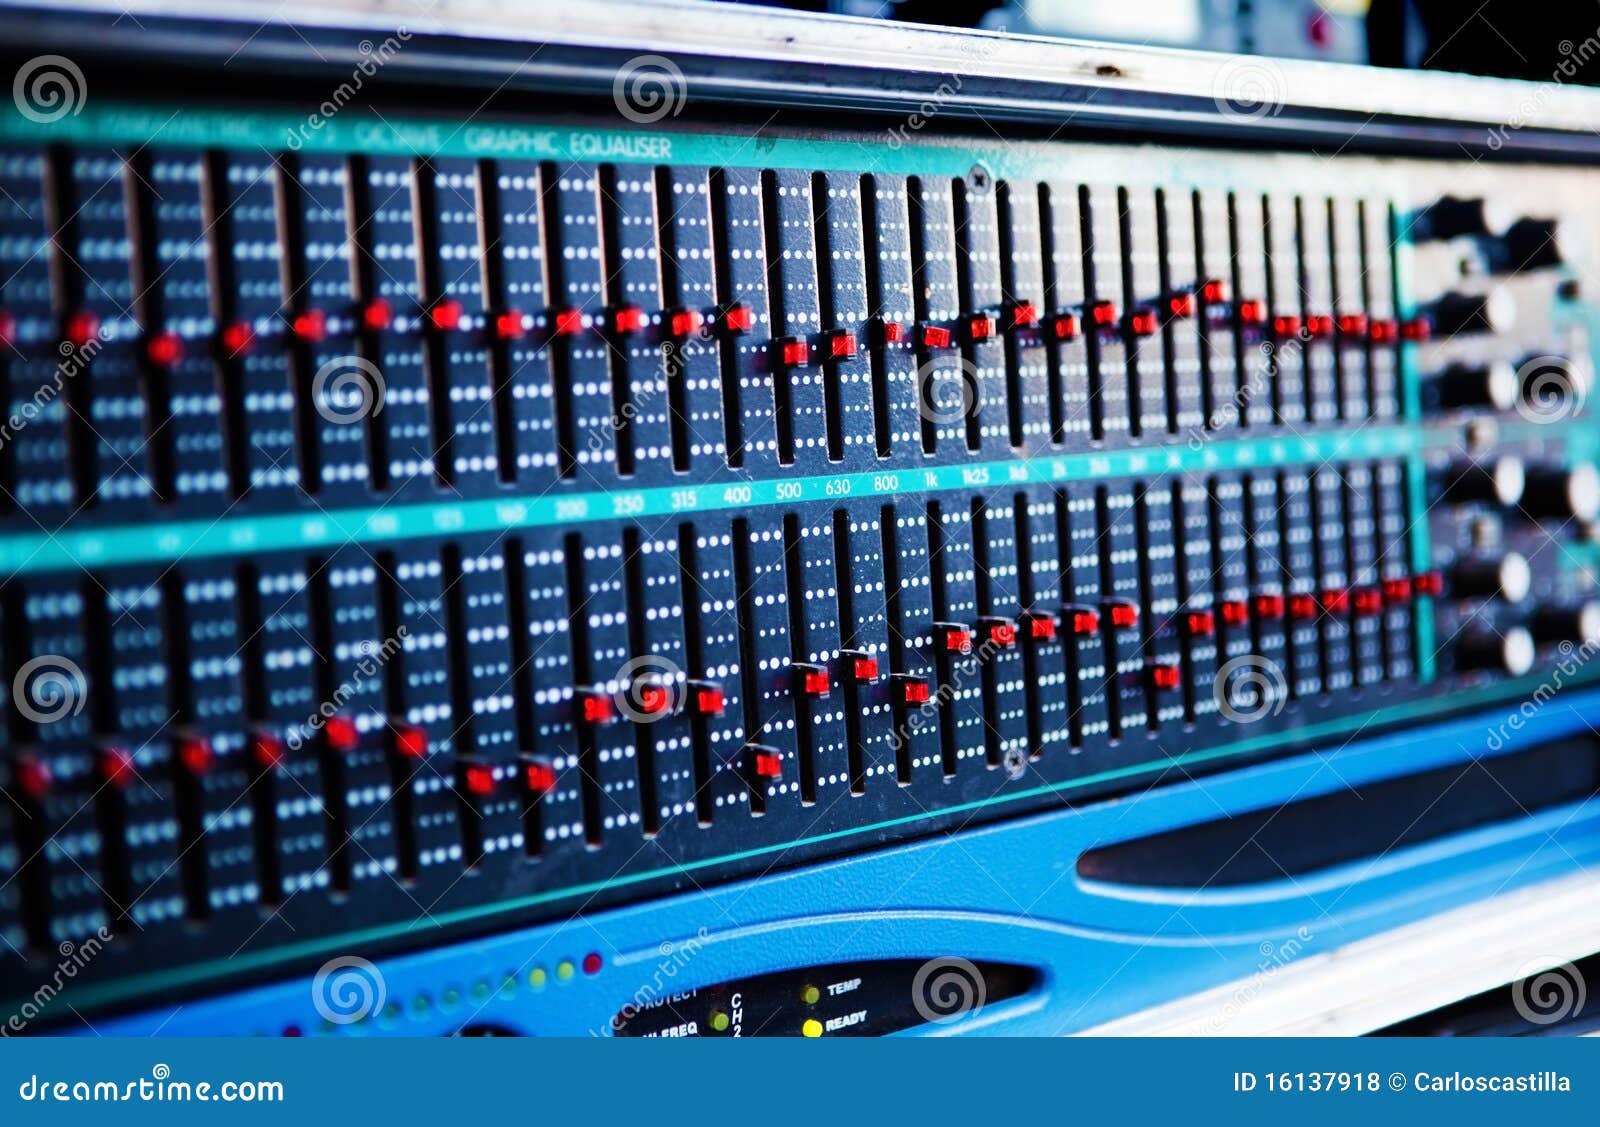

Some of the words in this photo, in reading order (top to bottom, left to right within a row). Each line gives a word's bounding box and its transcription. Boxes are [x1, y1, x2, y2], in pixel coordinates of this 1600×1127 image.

[463, 127, 558, 154] GRAPHIC
[569, 132, 671, 159] EQUALISER
[555, 499, 588, 520] 200
[613, 494, 645, 515] 250
[671, 490, 697, 510] 315
[723, 486, 751, 504] 400
[776, 482, 802, 500] 500
[825, 478, 851, 496] 630
[874, 474, 899, 492] 800
[924, 471, 938, 488] 1k
[962, 467, 990, 485] 1k25
[827, 978, 862, 996] TEMP
[825, 1010, 868, 1032] READY
